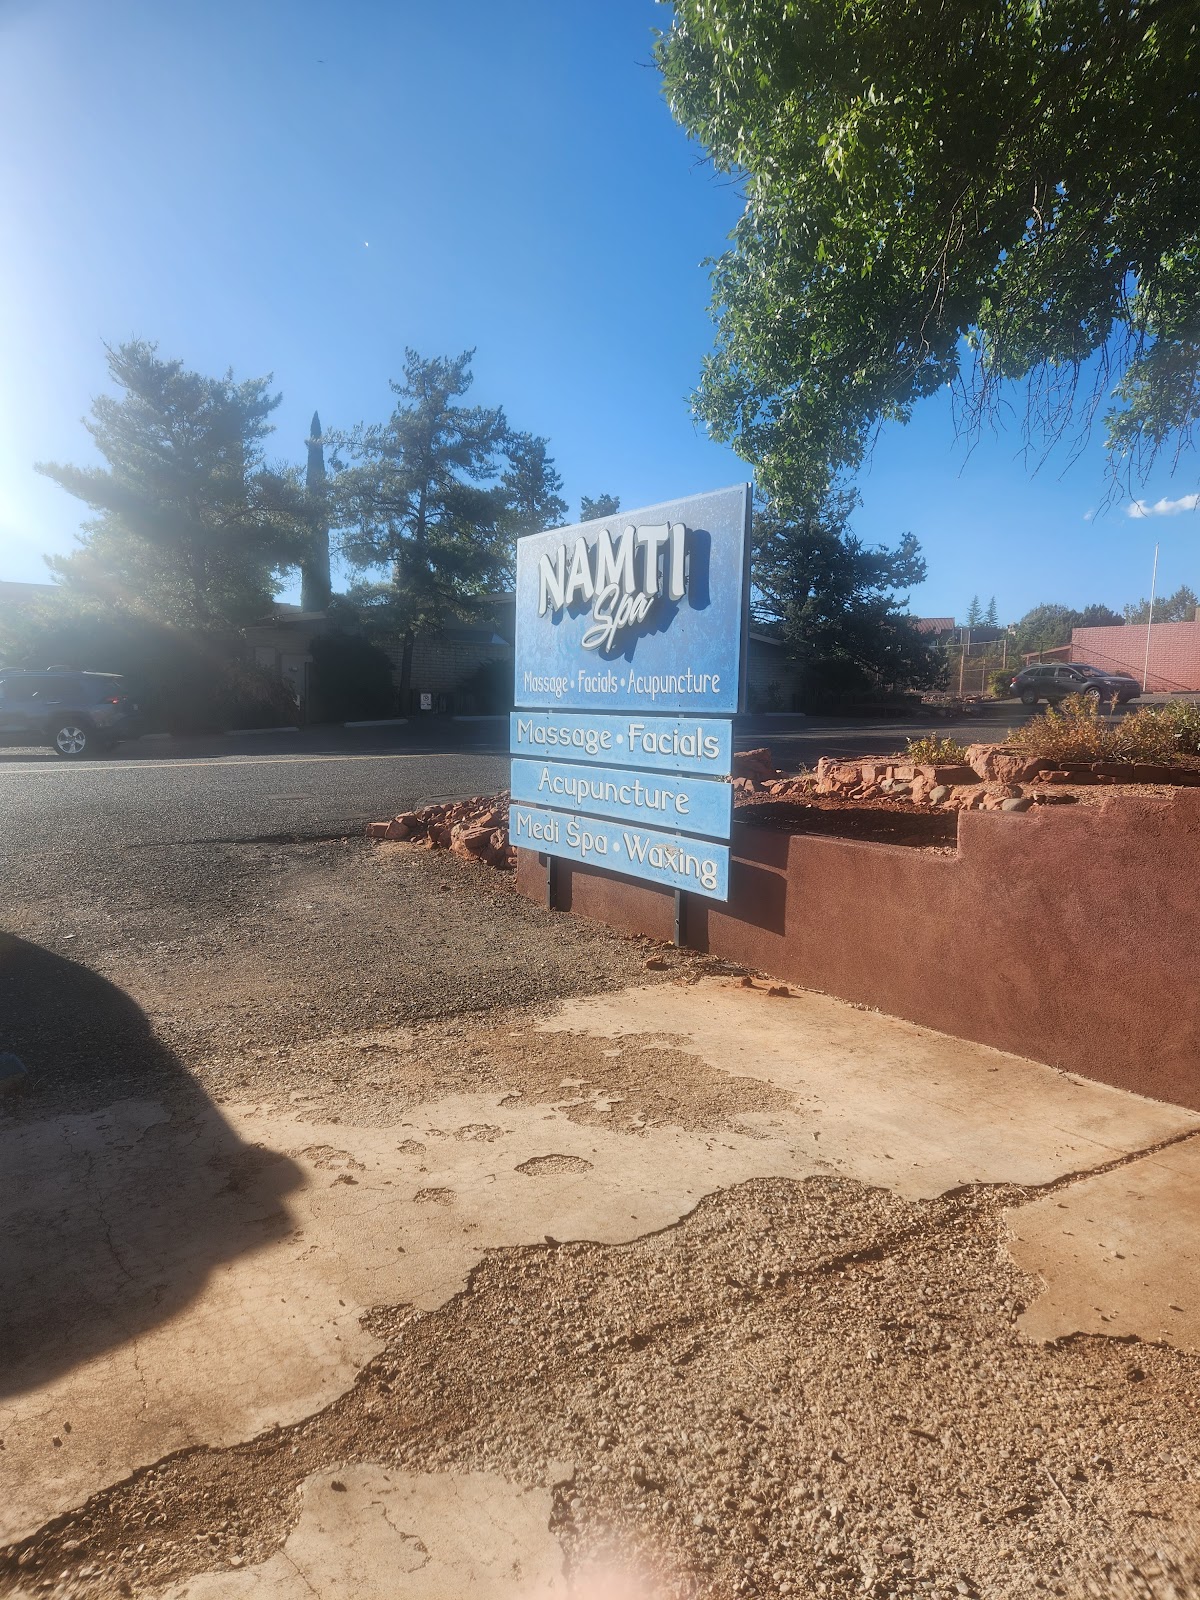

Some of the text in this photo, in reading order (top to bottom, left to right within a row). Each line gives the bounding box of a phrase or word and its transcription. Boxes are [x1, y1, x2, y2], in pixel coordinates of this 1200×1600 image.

[538, 521, 687, 618] NAMTI
[581, 582, 654, 653] Spa
[524, 668, 721, 700] Massage Facials Acupuncture
[516, 719, 720, 759] Massage Facials
[538, 767, 690, 814] Acupuncture
[516, 812, 718, 890] Medi Spa Waxing
